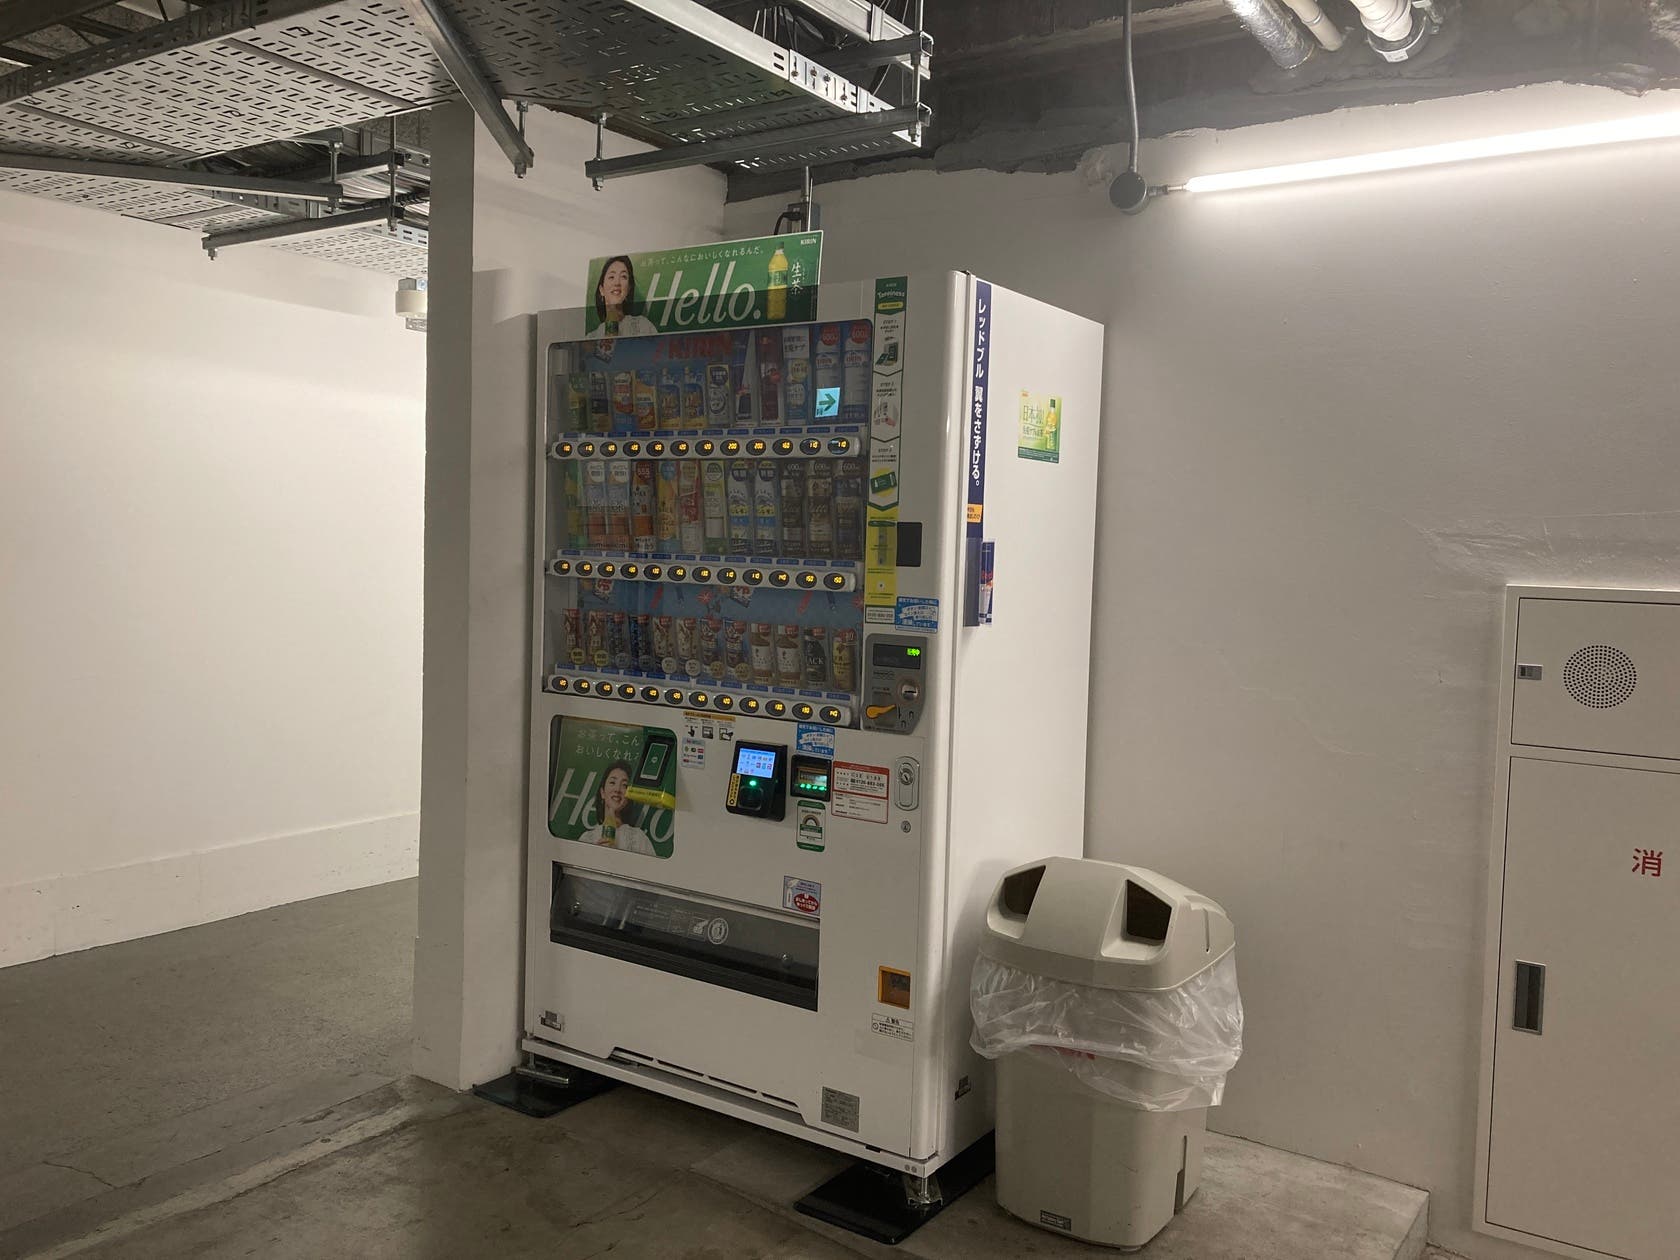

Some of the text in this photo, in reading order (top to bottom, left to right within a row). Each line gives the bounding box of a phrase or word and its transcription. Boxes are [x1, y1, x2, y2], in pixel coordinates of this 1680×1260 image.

[645, 260, 762, 327] Hello.
[971, 299, 987, 487] レッドブル 翼をさずける。
[1631, 847, 1663, 878] 消
